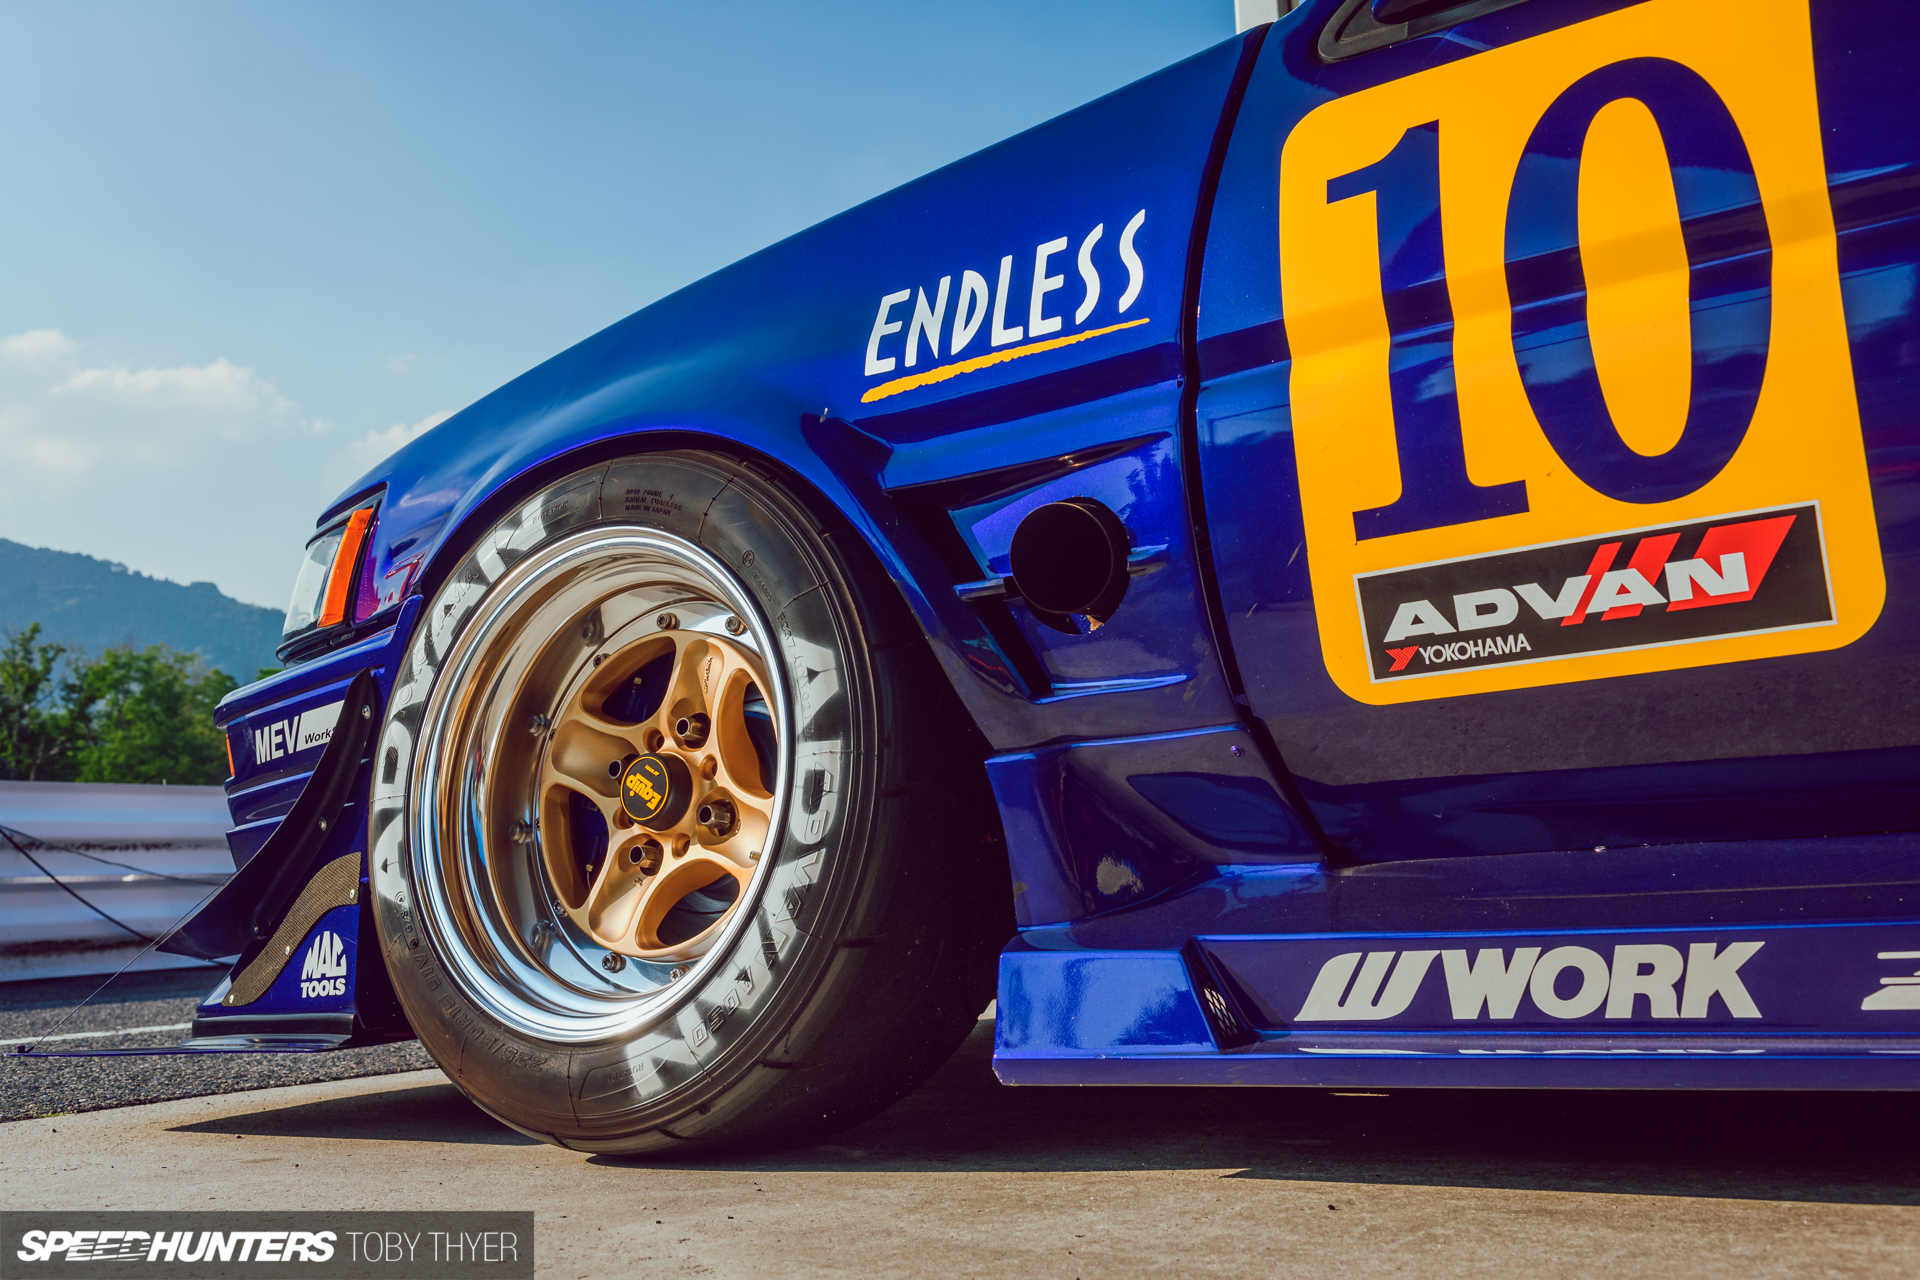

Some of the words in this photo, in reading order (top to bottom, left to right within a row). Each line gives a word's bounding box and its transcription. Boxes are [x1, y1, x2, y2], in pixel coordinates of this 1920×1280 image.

[864, 208, 1146, 377] ENDLESS
[1326, 56, 1773, 543] 10
[532, 499, 569, 525] ROTATION
[652, 506, 671, 516] JAPAN
[1383, 552, 1750, 643] ADVAN
[1418, 633, 1532, 665] YOKOHAMA
[255, 715, 300, 765] MEV
[304, 727, 335, 745] Work
[626, 772, 663, 811] Equip
[301, 930, 347, 980] MAC
[300, 978, 346, 999] TOOLS
[1441, 941, 1765, 1020] WORK
